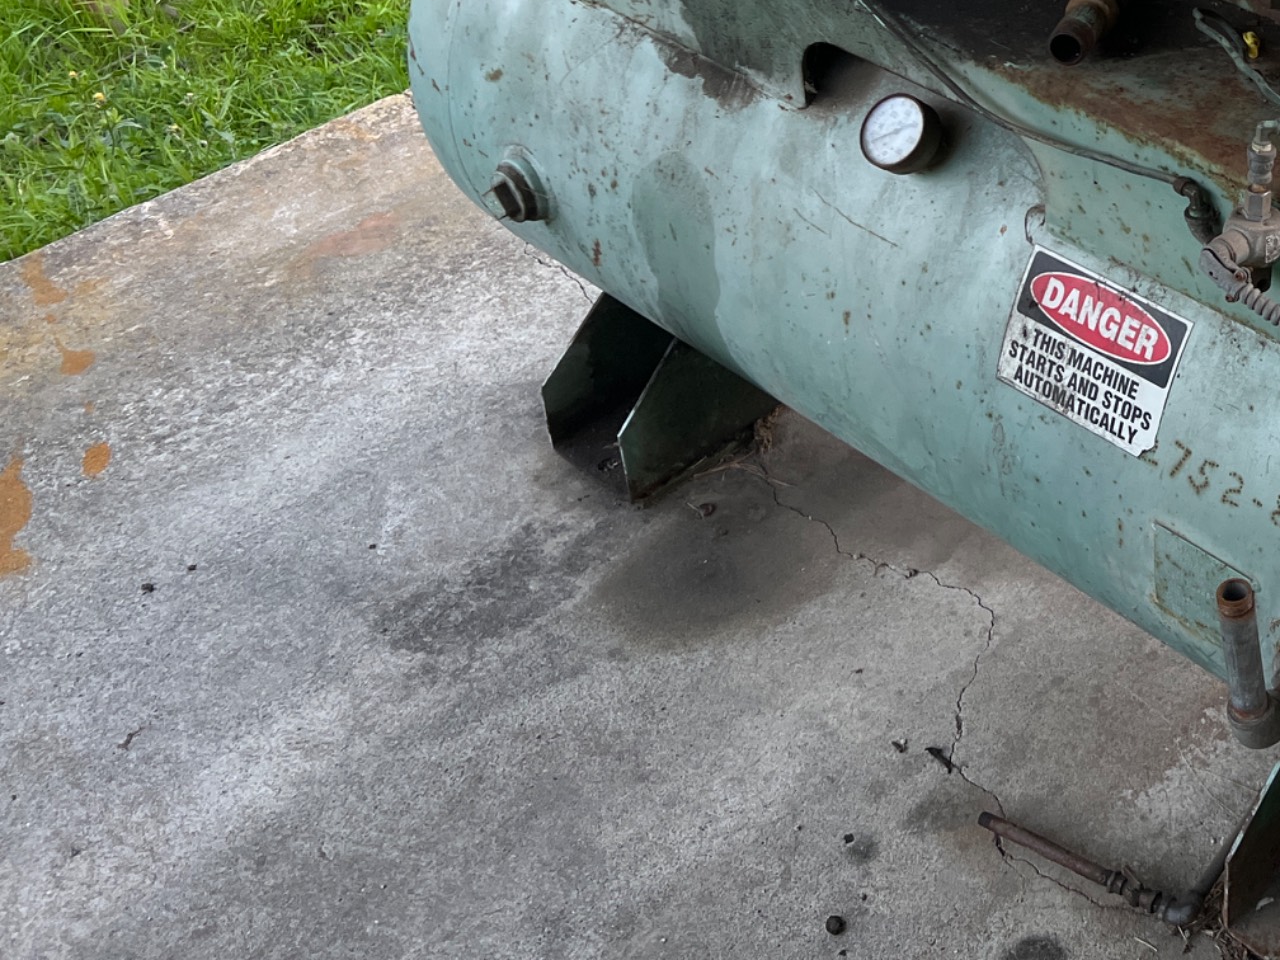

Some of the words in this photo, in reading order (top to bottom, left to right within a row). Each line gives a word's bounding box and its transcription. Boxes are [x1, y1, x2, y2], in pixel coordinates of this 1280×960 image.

[1041, 277, 1159, 360] DANGER
[1009, 340, 1065, 383] STARTS
[1067, 373, 1099, 401] AND
[1102, 390, 1152, 431] STOPS
[1013, 365, 1138, 444] AUTOMATICALLY
[1033, 328, 1066, 360] THIS
[1067, 347, 1139, 400] MACHINE
